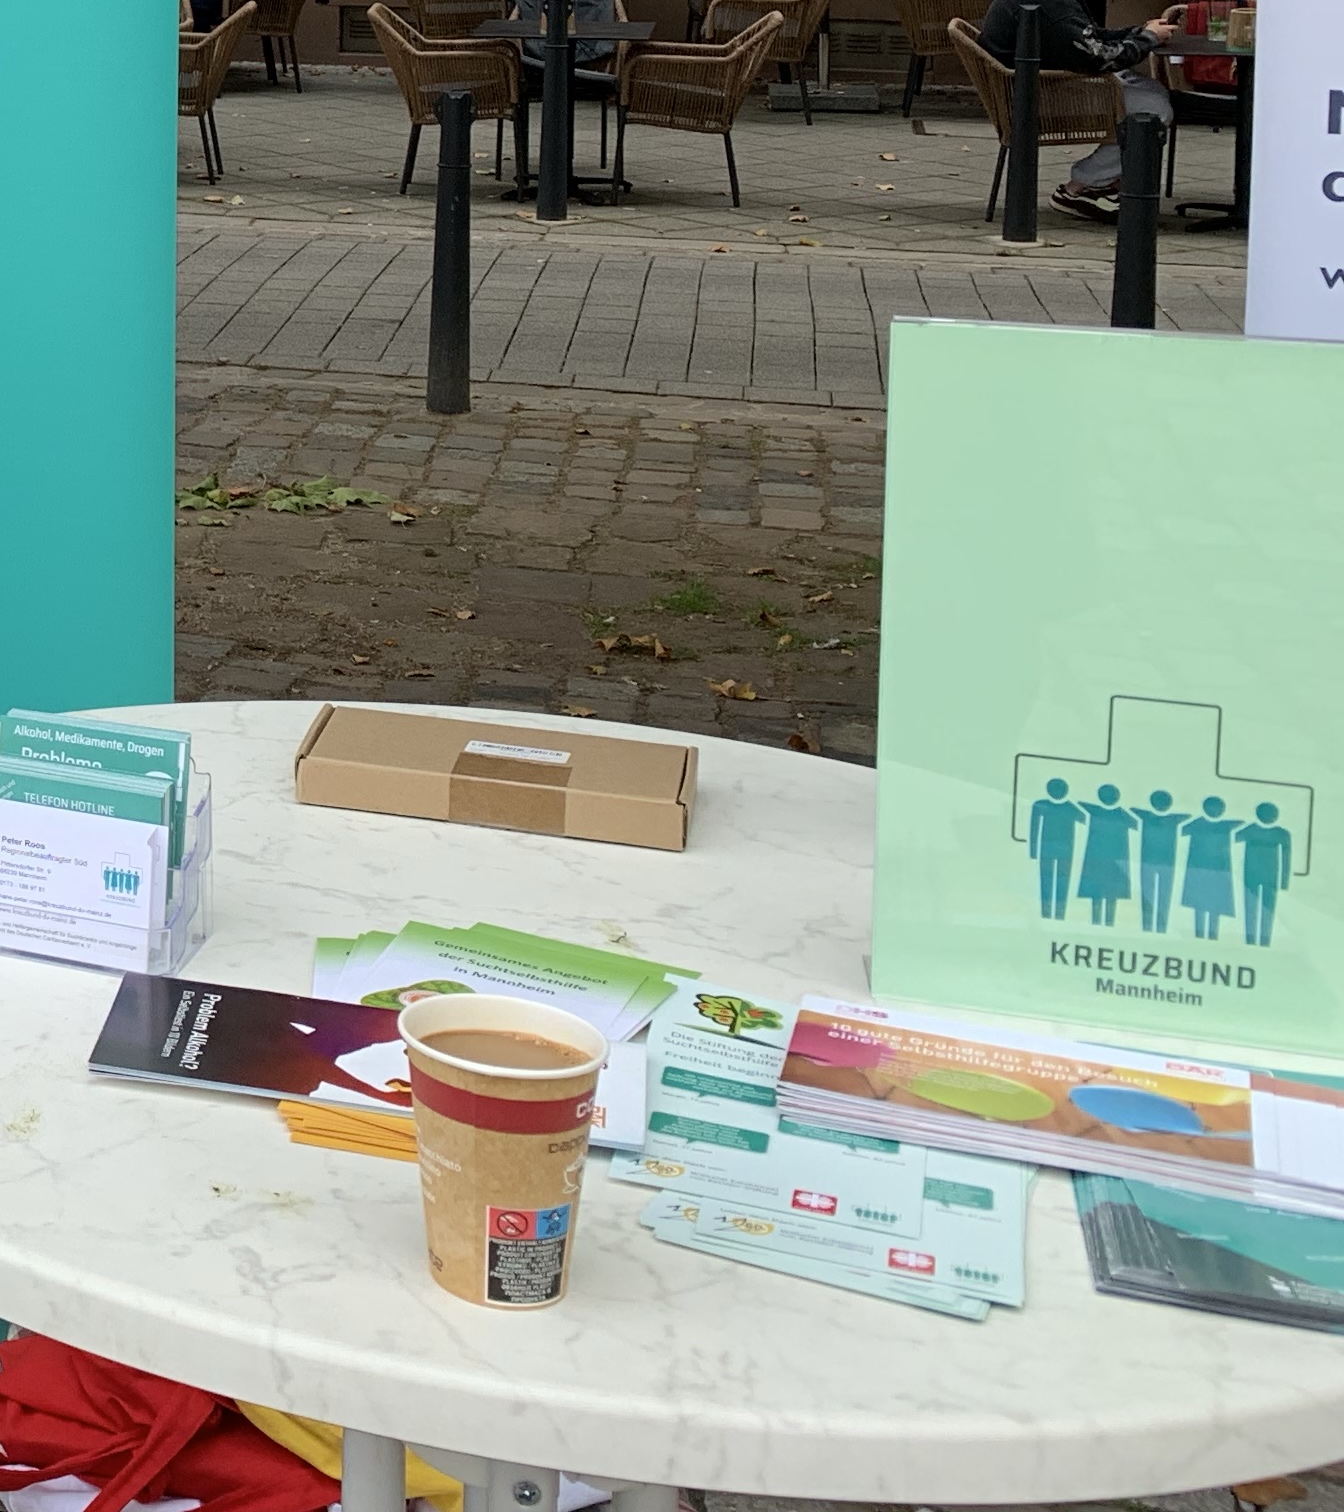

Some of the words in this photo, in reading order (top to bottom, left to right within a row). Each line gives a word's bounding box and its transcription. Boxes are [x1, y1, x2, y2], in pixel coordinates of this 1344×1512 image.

[14, 725, 53, 741] Alkohol,
[55, 731, 125, 752] Medikamente,
[127, 741, 164, 757] Drogen
[24, 792, 69, 809] TELEFON
[71, 800, 115, 816] HOTLINE
[1, 835, 22, 846] Peter
[24, 840, 46, 850] Roos
[1, 846, 72, 864] Regionalbeauftragter
[74, 857, 88, 867] Süd
[434, 940, 540, 971] Gemeinsames
[542, 966, 609, 986] Angebot
[438, 951, 464, 963] der
[466, 958, 588, 993] Suchtselbsthilfe
[1050, 941, 1257, 990] KREUZBUND
[453, 965, 468, 974] in
[471, 970, 556, 996] Mannheim
[1095, 976, 1204, 1007] Mannheim
[193, 992, 222, 1030] Problem
[178, 1030, 210, 1071] Alkohol?
[663, 1037, 779, 1068] Suchtselbsthilfe
[665, 1051, 722, 1069] Freiheit
[671, 1031, 697, 1042] Die
[699, 1038, 756, 1059] Stiftung
[828, 1030, 883, 1046] einer
[889, 1041, 1079, 1083] Selbsthilfegruppe
[831, 1022, 851, 1032] 10
[857, 1028, 903, 1041] gute
[910, 1036, 986, 1057] Gründe
[993, 1051, 1024, 1064] für
[1031, 1058, 1070, 1073] den
[1078, 1066, 1159, 1088] Besuch
